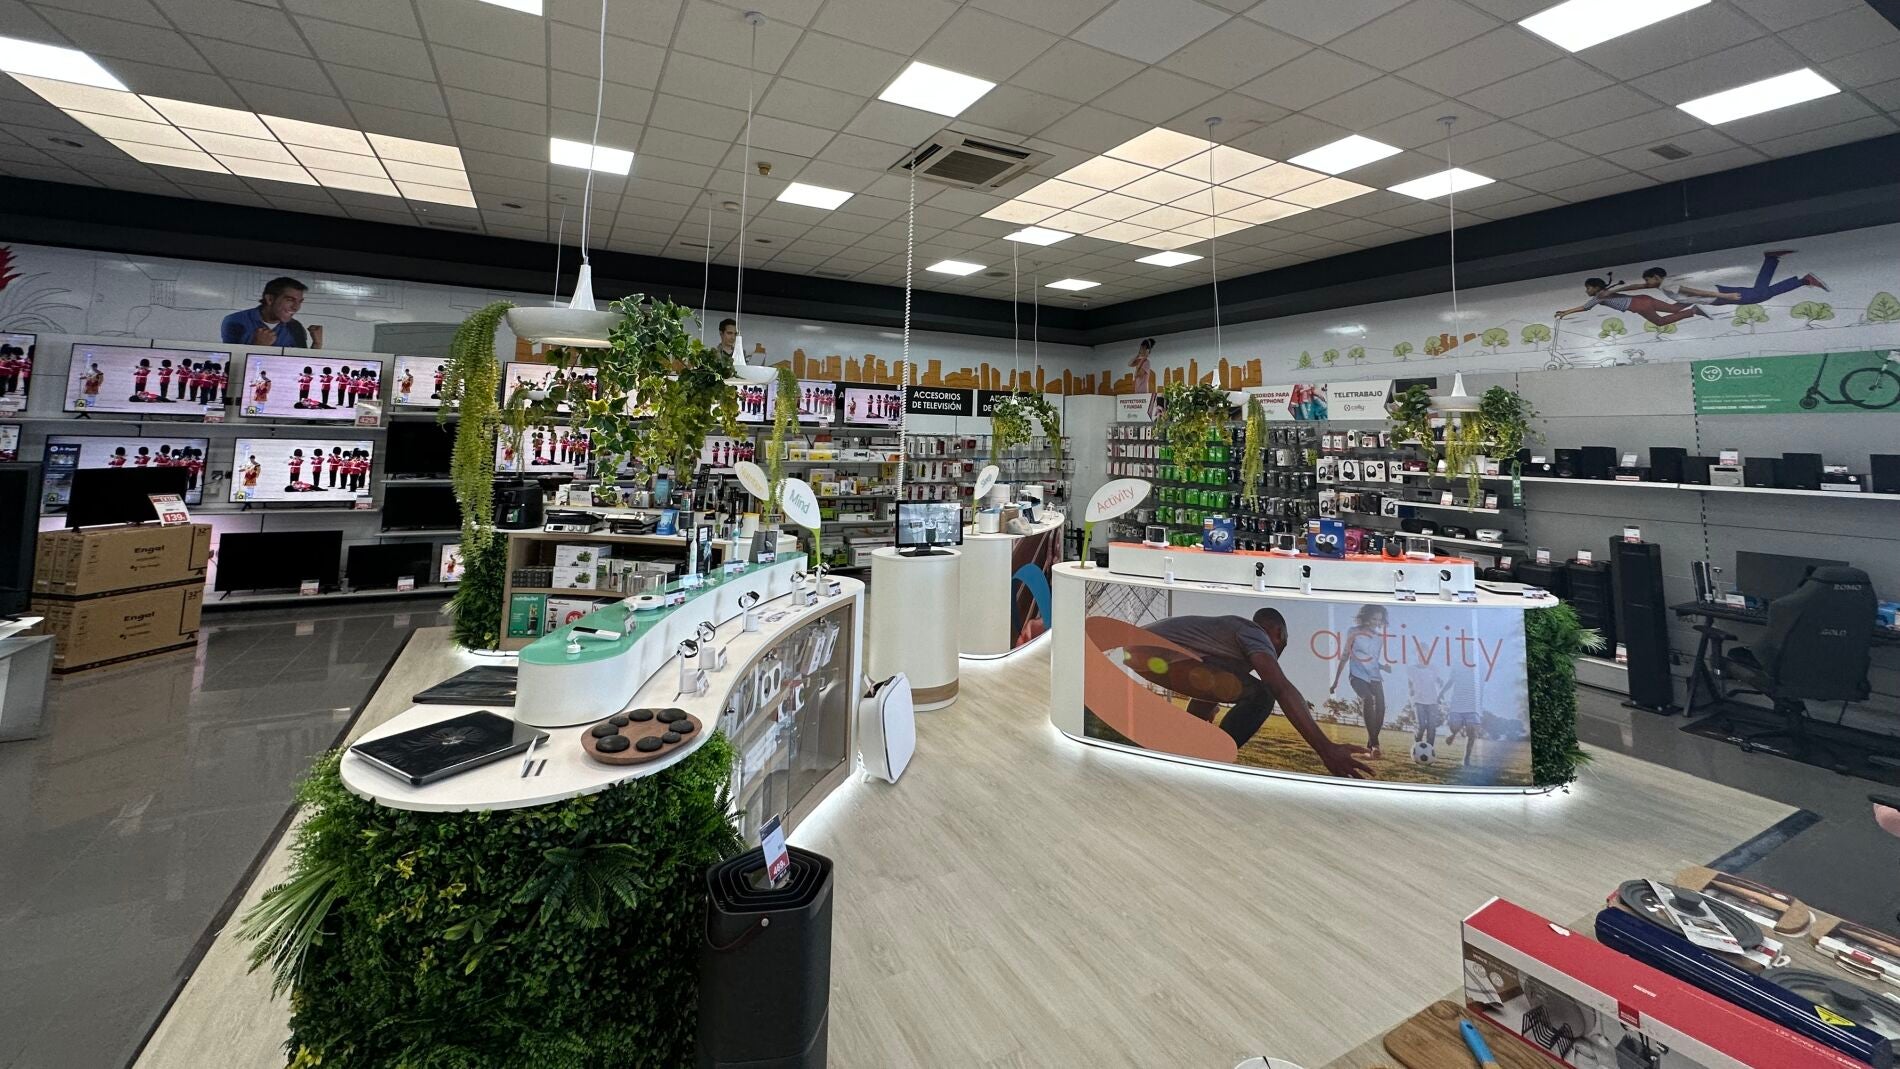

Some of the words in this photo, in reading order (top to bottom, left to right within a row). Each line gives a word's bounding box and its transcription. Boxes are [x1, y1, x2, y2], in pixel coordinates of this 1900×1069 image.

[1724, 366, 1763, 376] Youin
[913, 390, 961, 401] ACCESORIOS
[1334, 390, 1383, 398] TELETRABAJO
[912, 401, 922, 409] DE
[923, 401, 962, 411] TELEVISIÓN
[982, 404, 992, 412] DE
[789, 488, 811, 514] Mind
[1096, 485, 1135, 513] Activity
[1315, 533, 1338, 545] GO
[134, 544, 165, 555] Engel
[123, 611, 155, 622] Engel
[1310, 623, 1504, 682] activity
